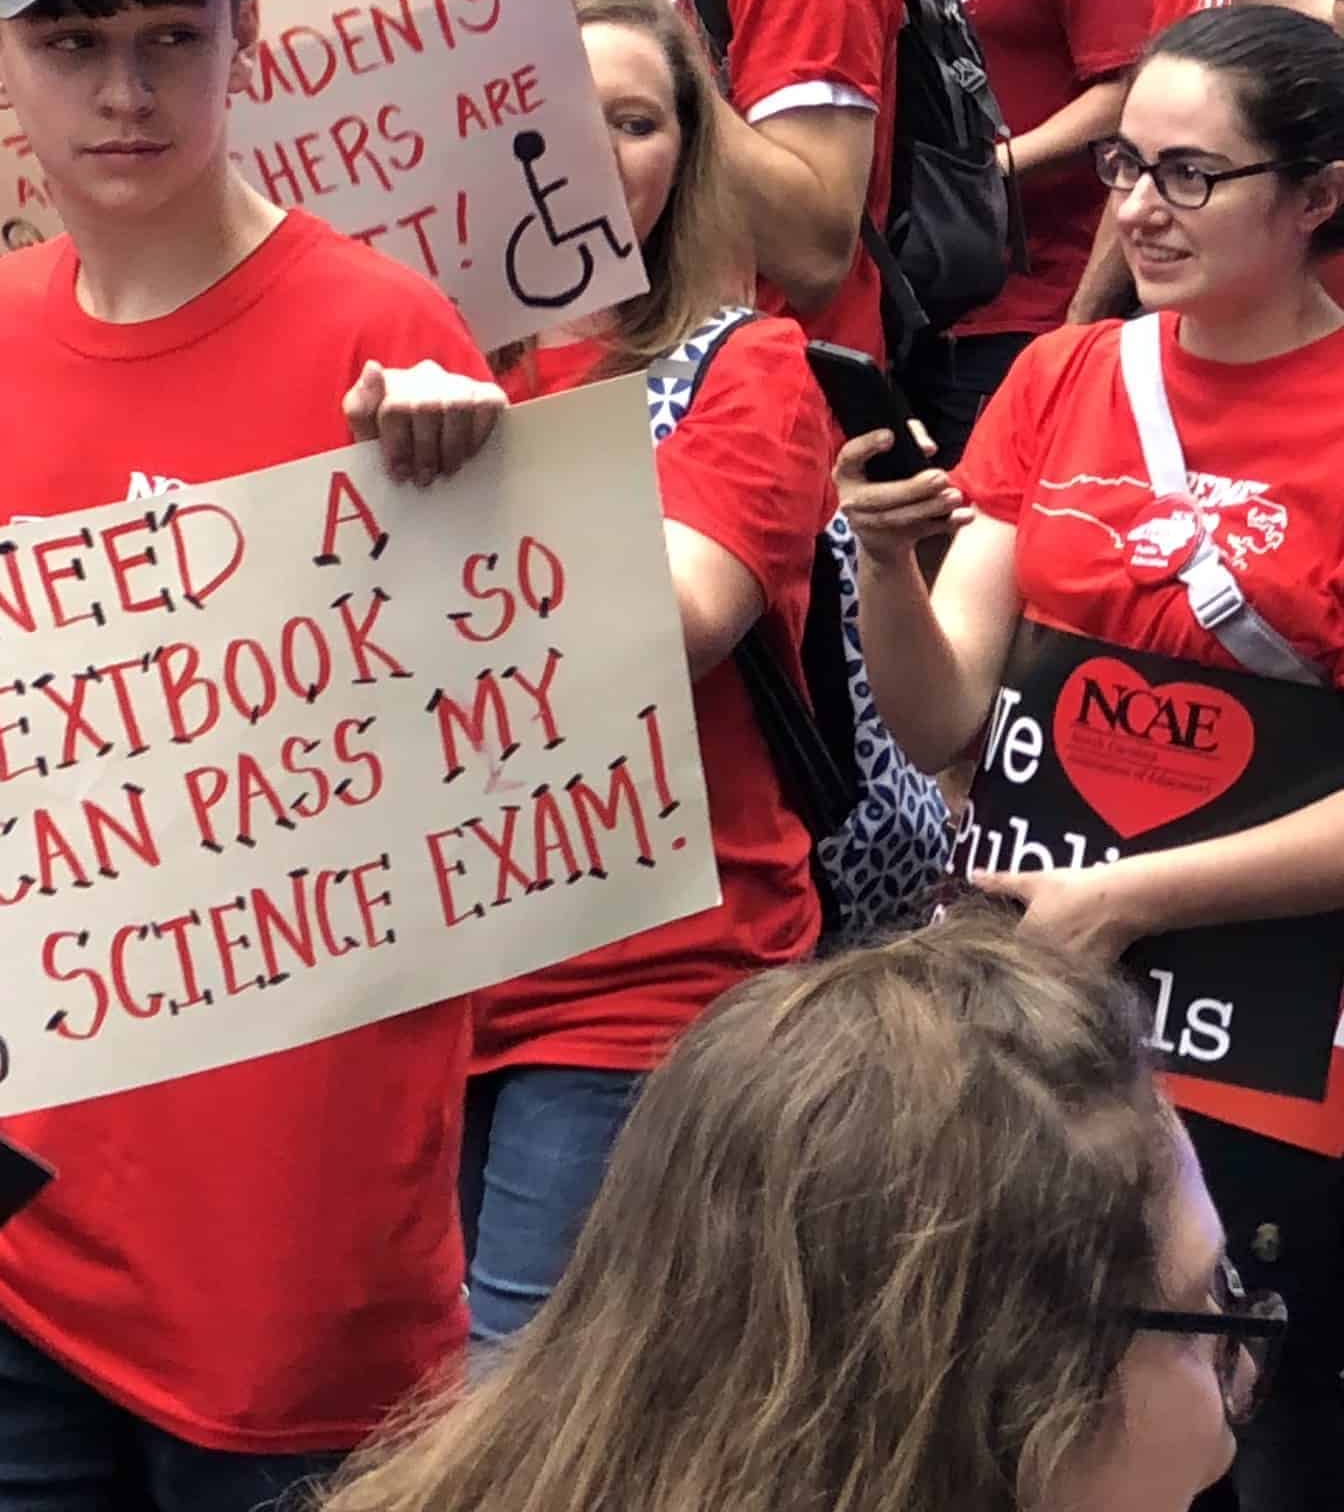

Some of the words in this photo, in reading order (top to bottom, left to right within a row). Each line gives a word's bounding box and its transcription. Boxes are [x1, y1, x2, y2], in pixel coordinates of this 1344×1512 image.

[252, 103, 425, 205] HERS
[456, 64, 546, 138] ARE
[313, 470, 388, 565] A
[445, 535, 565, 645] SO
[185, 716, 385, 855] PASS
[425, 648, 567, 785] MY
[1078, 678, 1222, 754] NCAE
[41, 854, 396, 1041] SCIENCE
[425, 705, 689, 929] EXAM!
